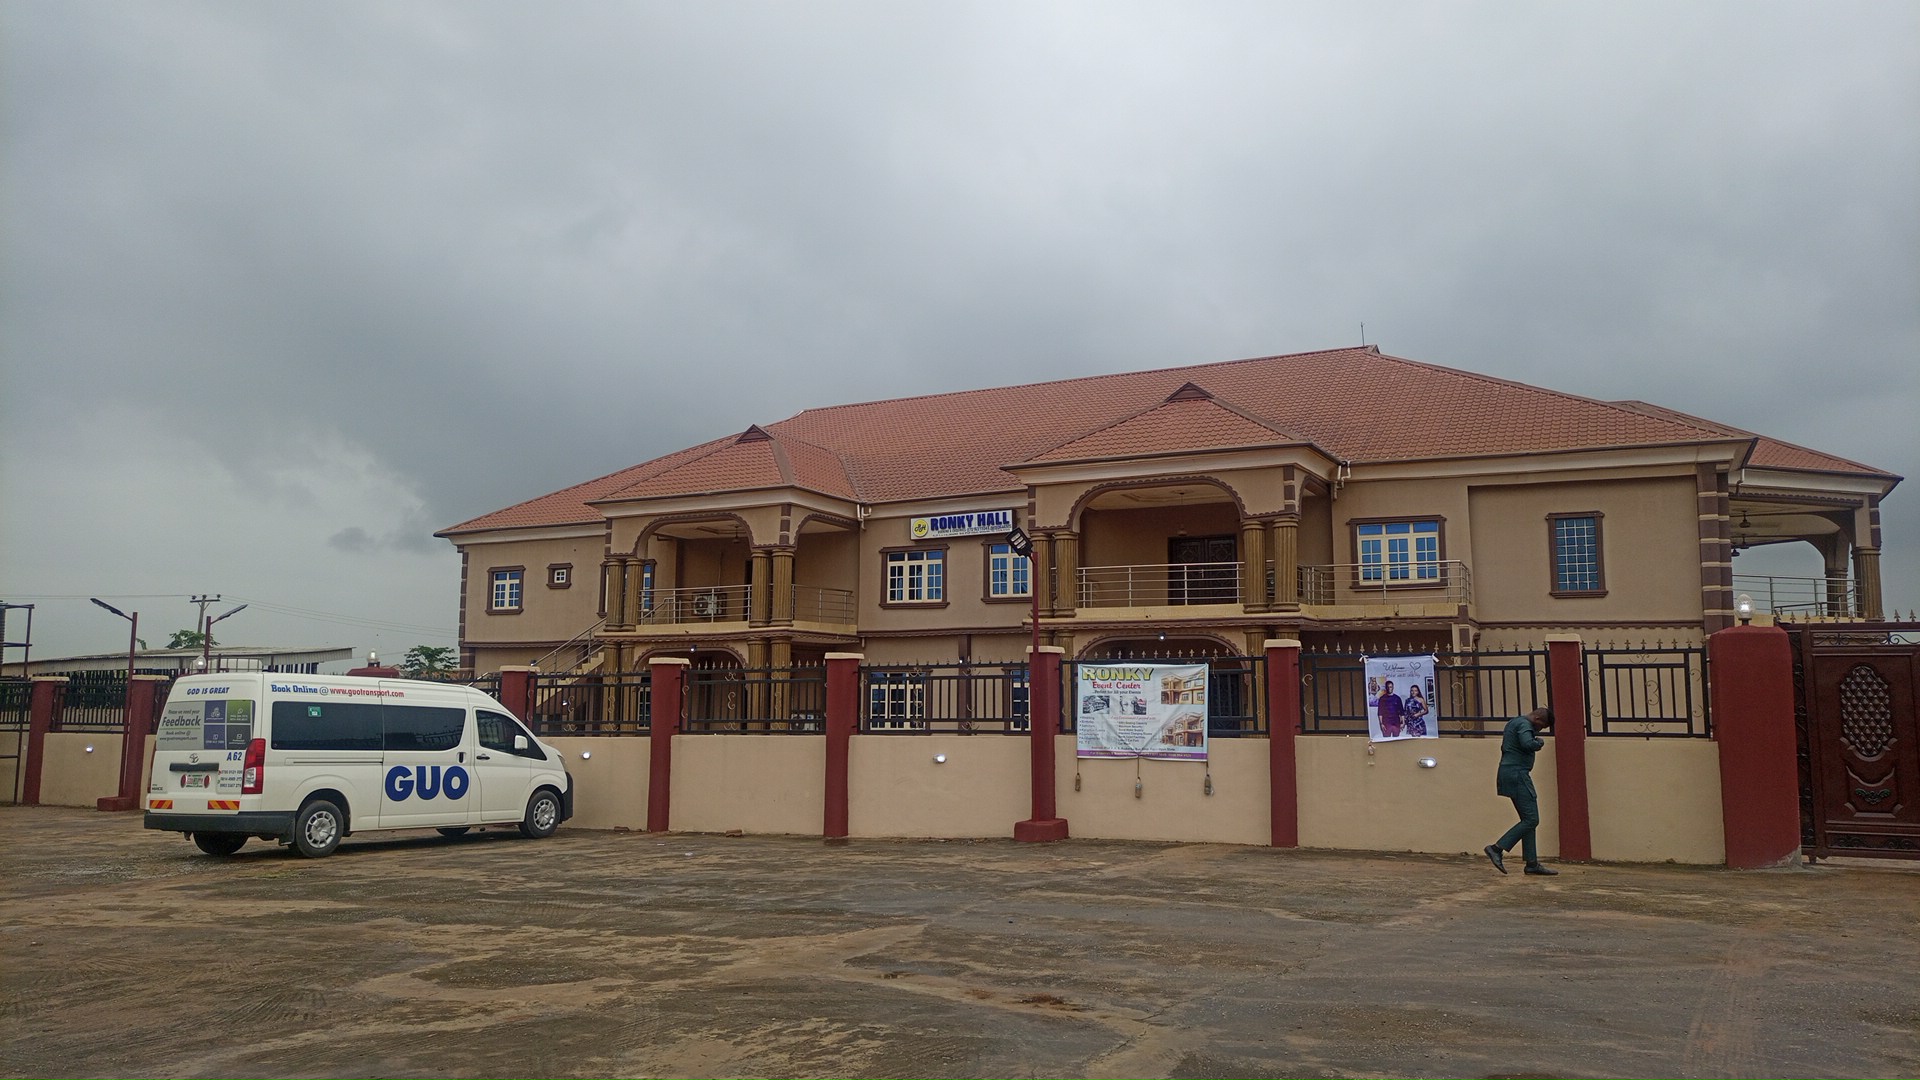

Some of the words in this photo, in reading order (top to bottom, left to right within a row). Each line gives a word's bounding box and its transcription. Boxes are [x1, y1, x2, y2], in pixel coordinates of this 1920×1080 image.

[931, 515, 974, 531] RONKY
[977, 512, 1009, 526] HALL
[1082, 667, 1154, 681] RONKY
[271, 684, 291, 693] Book
[293, 685, 318, 694] Online
[319, 686, 329, 696] @
[330, 687, 404, 698] www.guotransport.com
[1092, 681, 1112, 689] Event
[1116, 681, 1141, 689] Center
[162, 715, 201, 727] Feedback
[385, 765, 469, 802] GUO
